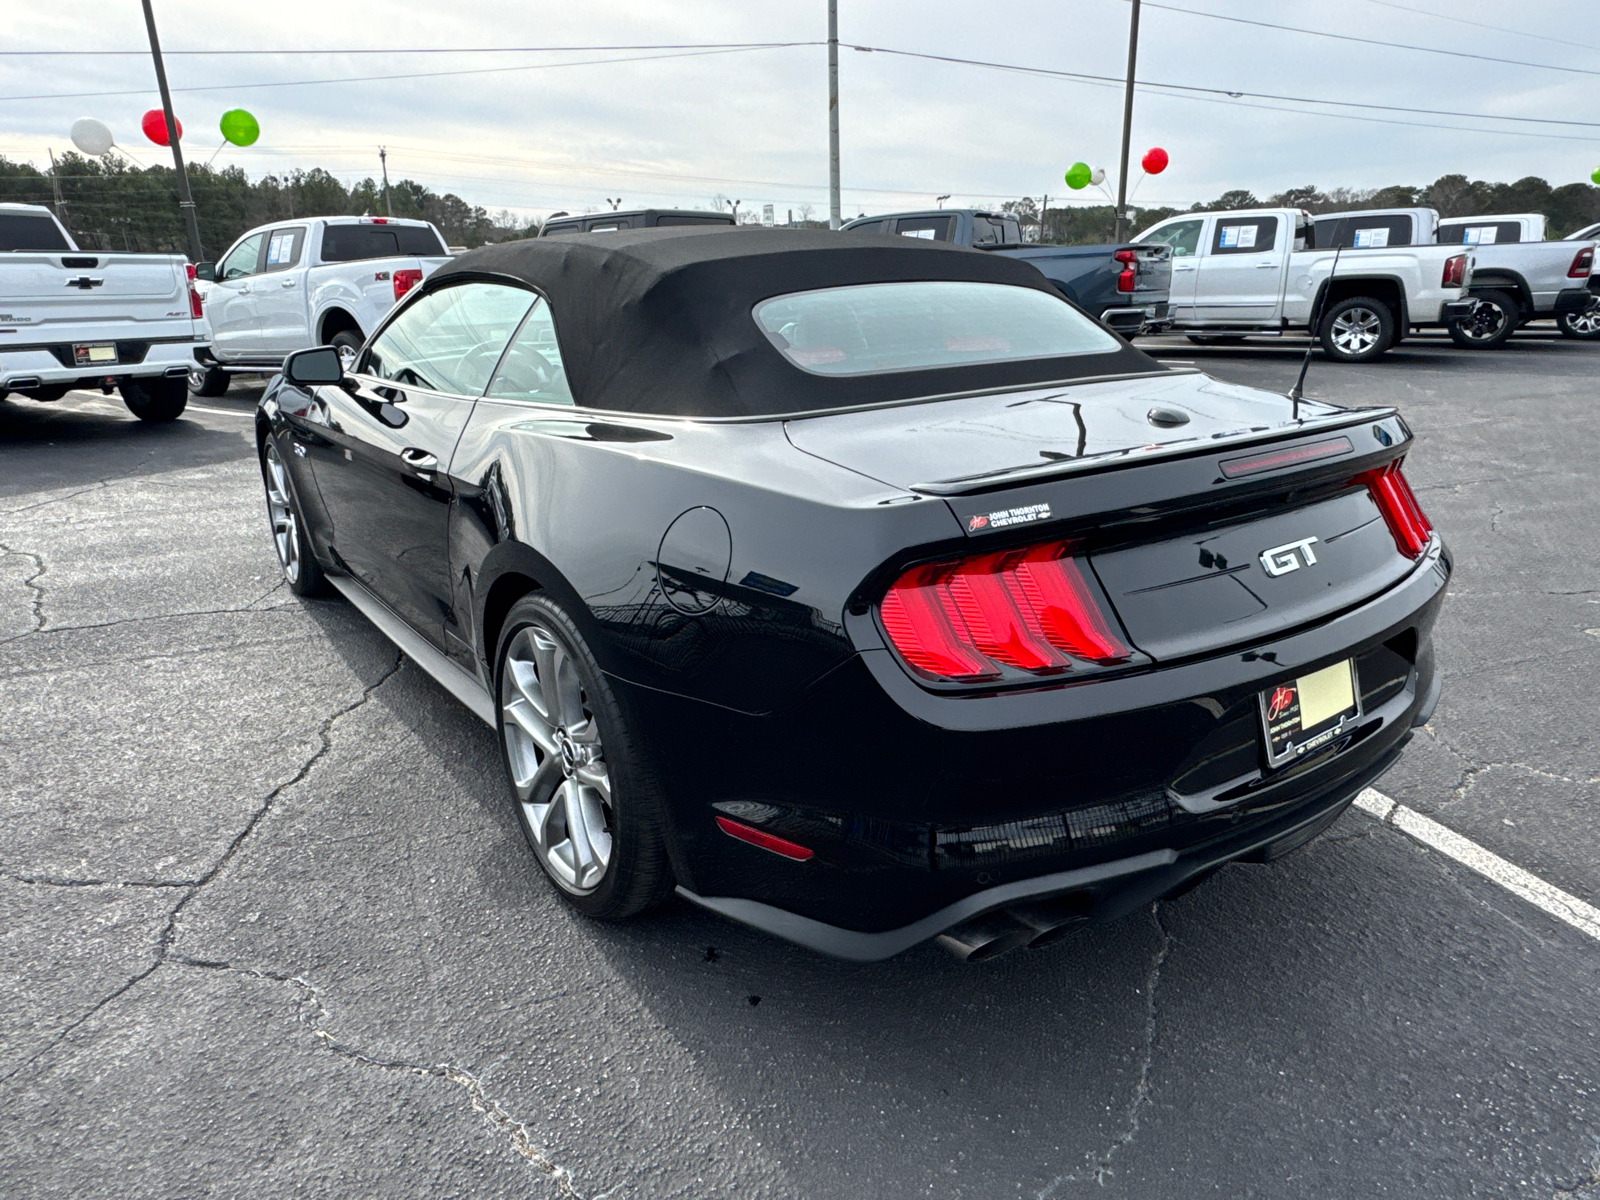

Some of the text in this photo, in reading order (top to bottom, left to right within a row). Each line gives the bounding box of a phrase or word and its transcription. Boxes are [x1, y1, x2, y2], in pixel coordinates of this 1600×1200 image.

[989, 503, 1049, 521] JOHN THORNTON
[990, 513, 1036, 527] CHEVROLET
[1258, 536, 1318, 578] GT
